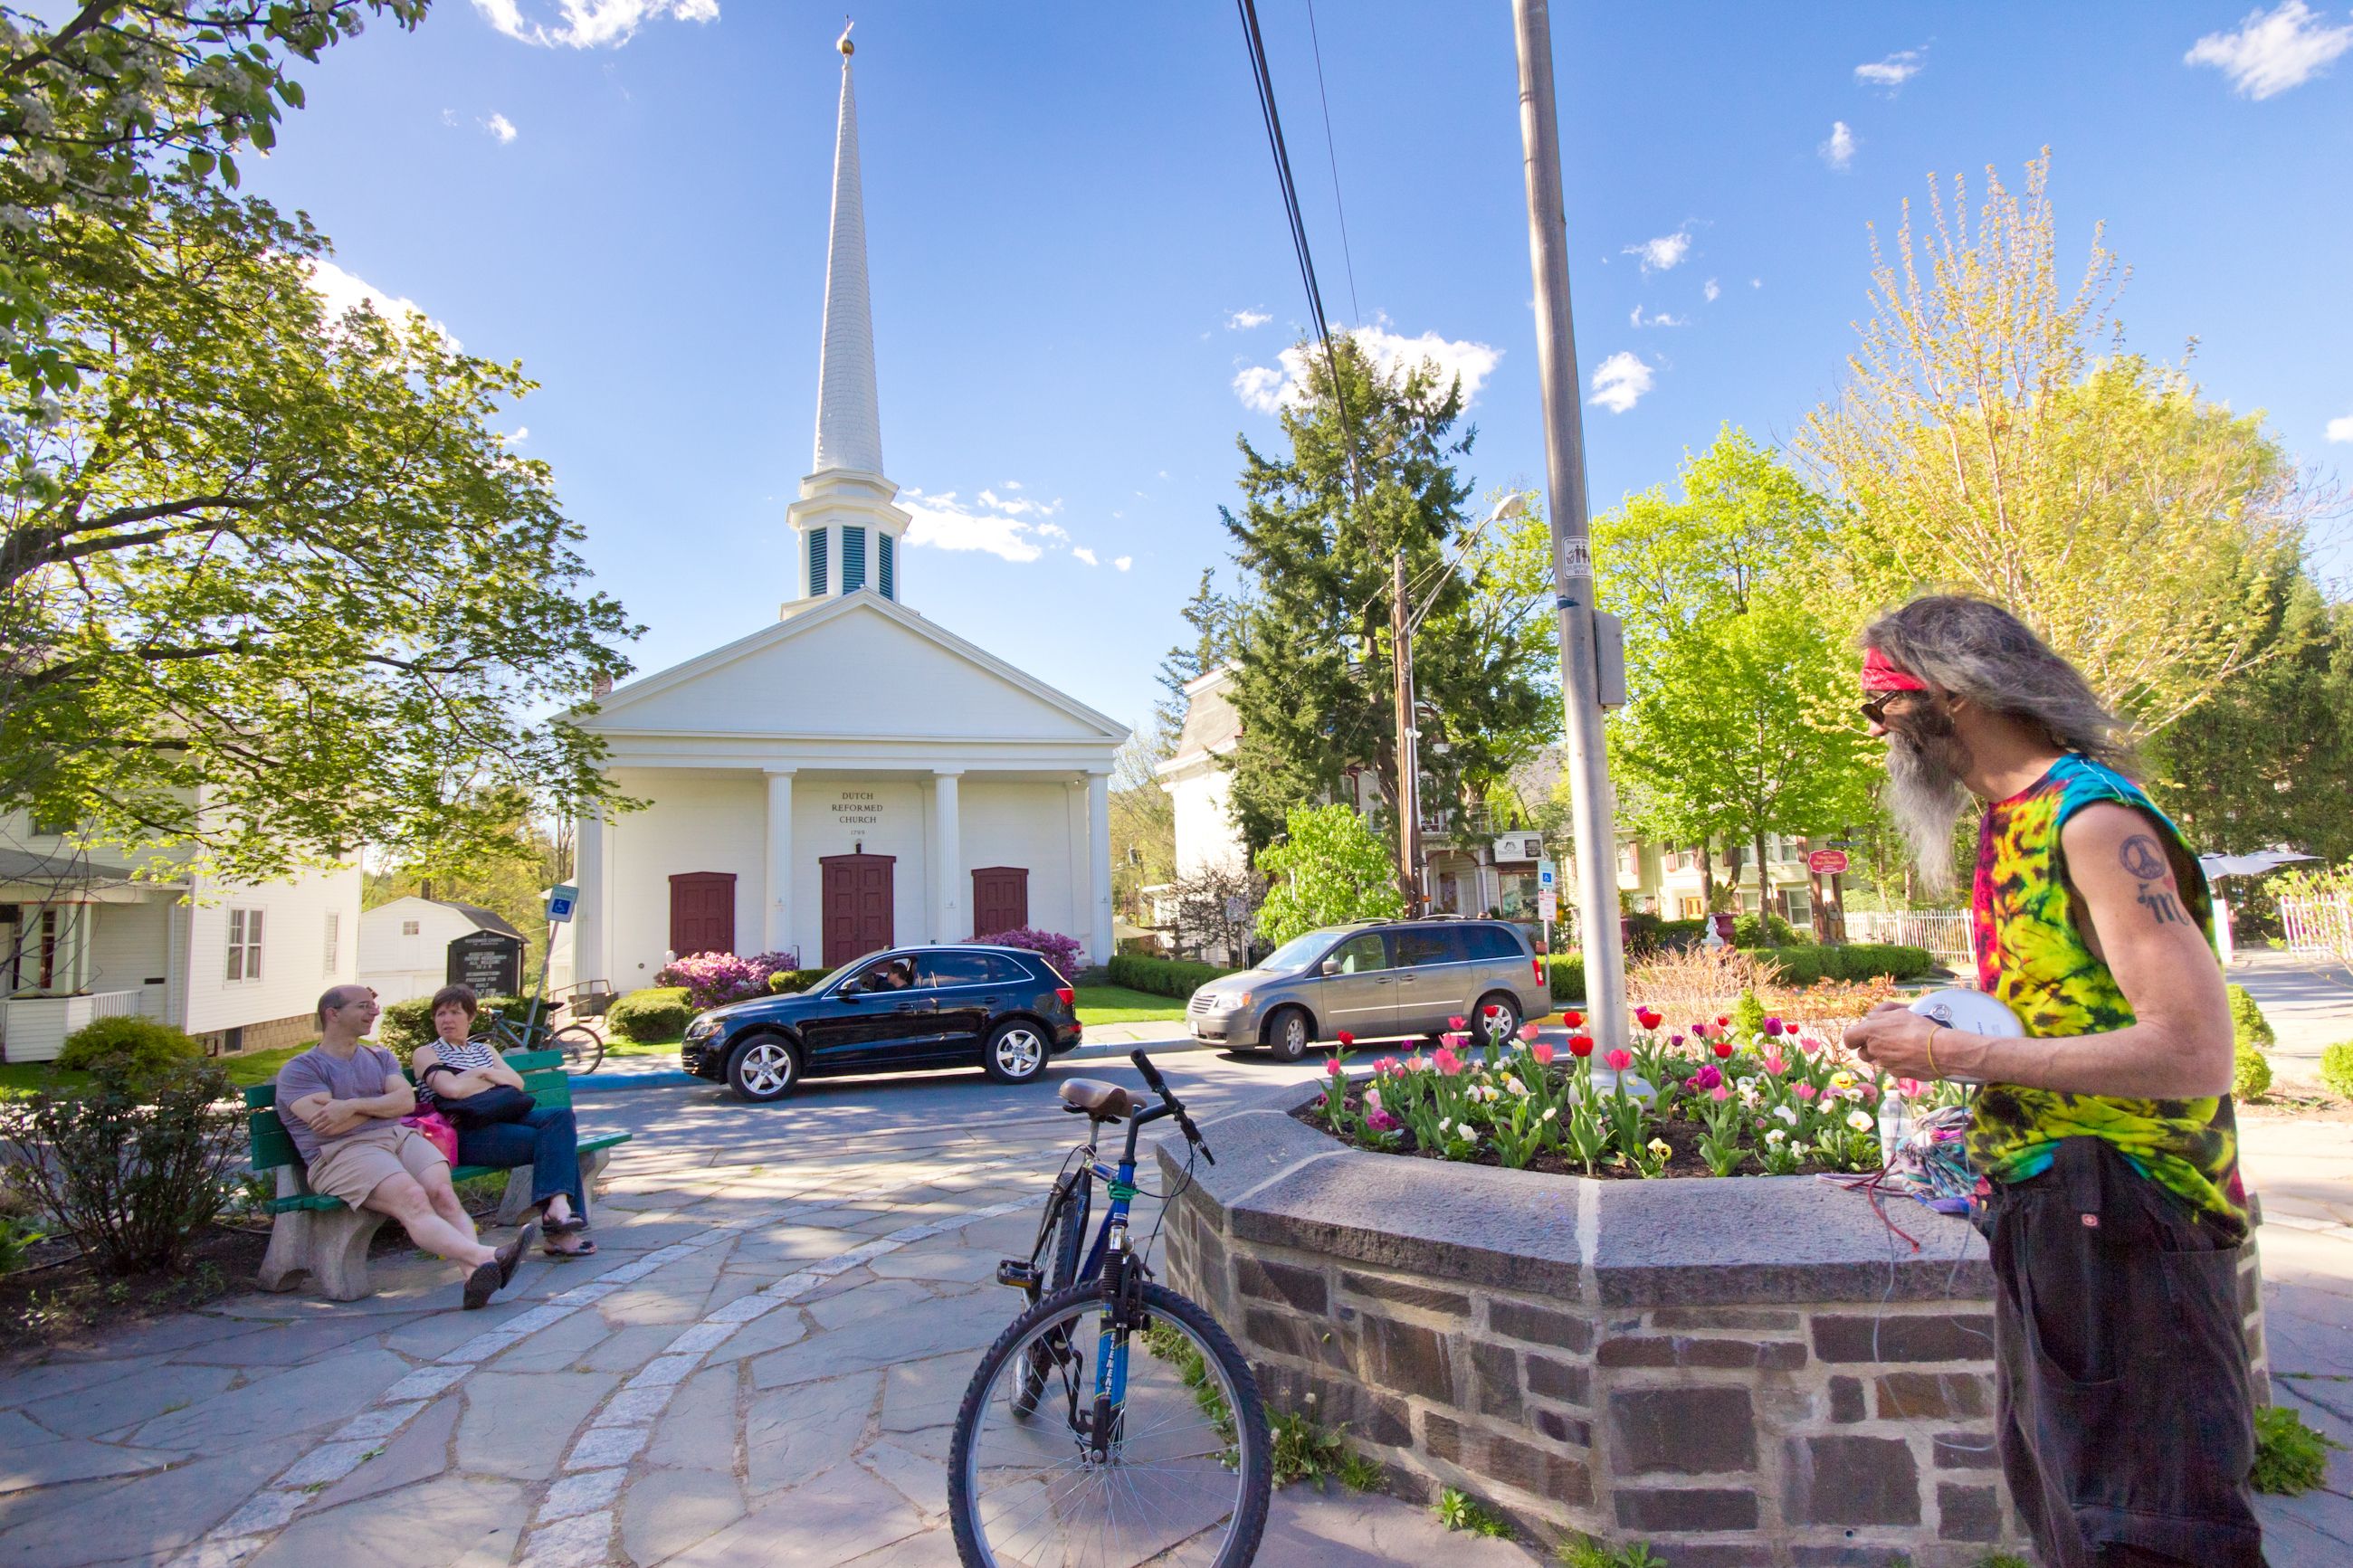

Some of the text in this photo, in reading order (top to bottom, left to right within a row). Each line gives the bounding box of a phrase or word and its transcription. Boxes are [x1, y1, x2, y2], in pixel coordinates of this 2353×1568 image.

[842, 792, 873, 800] DUTCH
[832, 803, 883, 812] REFORMED
[1104, 1331, 1116, 1396] ELEMENT
